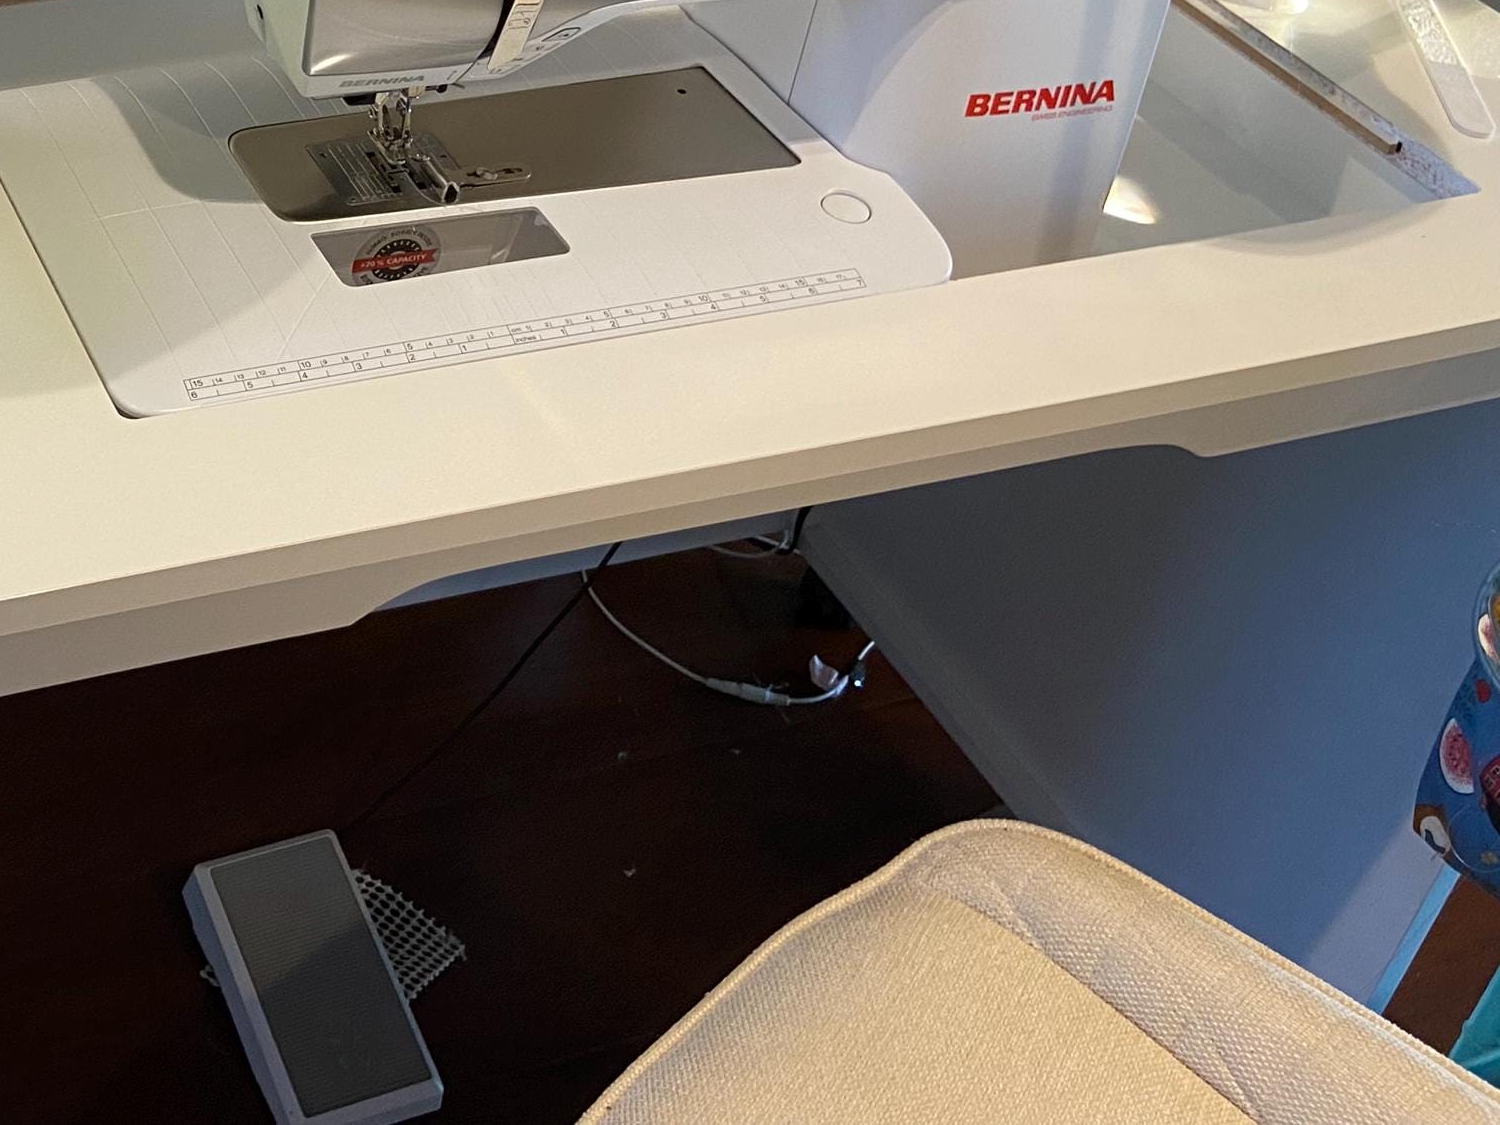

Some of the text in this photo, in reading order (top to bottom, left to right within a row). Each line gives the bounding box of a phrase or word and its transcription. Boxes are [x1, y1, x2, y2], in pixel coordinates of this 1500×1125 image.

[338, 76, 425, 88] BERNINA
[964, 79, 1116, 118] BERNINA
[386, 254, 428, 266] CAPACITY
